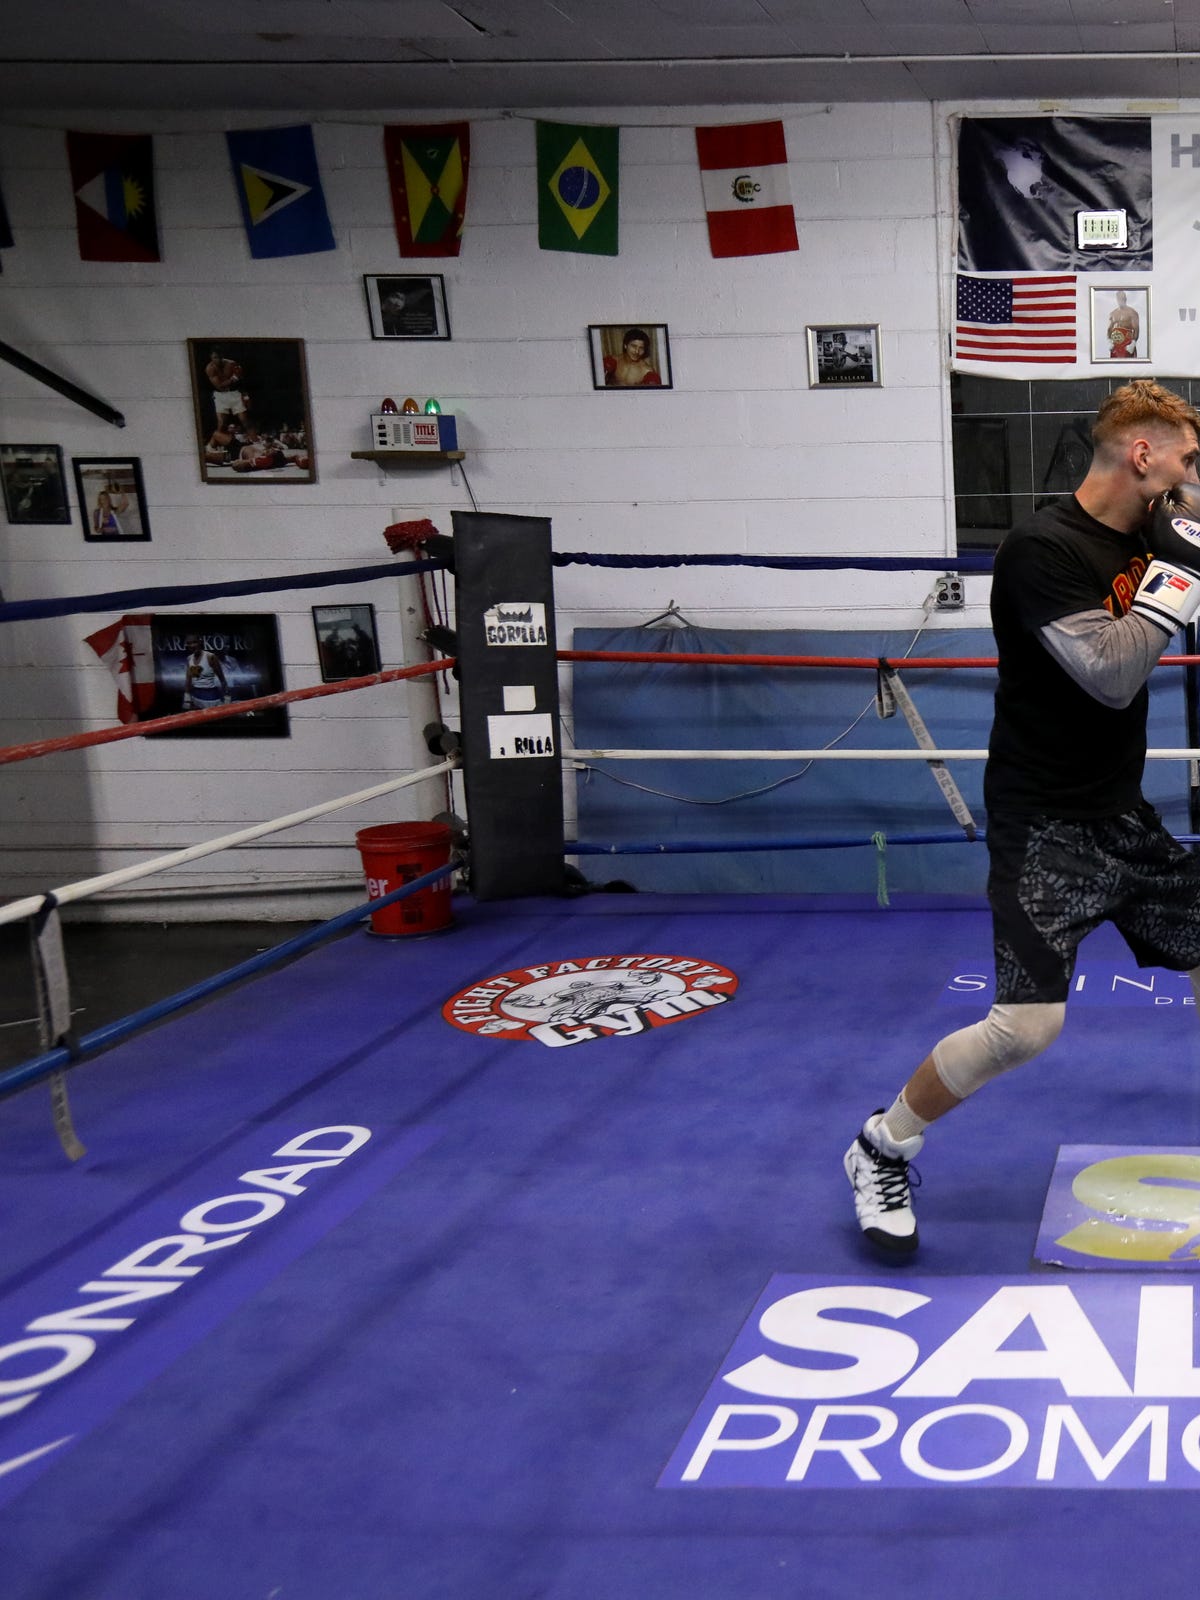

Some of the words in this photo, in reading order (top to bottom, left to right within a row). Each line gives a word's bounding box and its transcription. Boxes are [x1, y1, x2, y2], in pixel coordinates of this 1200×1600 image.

[415, 425, 435, 436] TITLE
[487, 625, 546, 644] GORILLA
[452, 975, 521, 1025] FIGHT
[524, 955, 722, 979] FACTORY
[528, 989, 734, 1048] Gym
